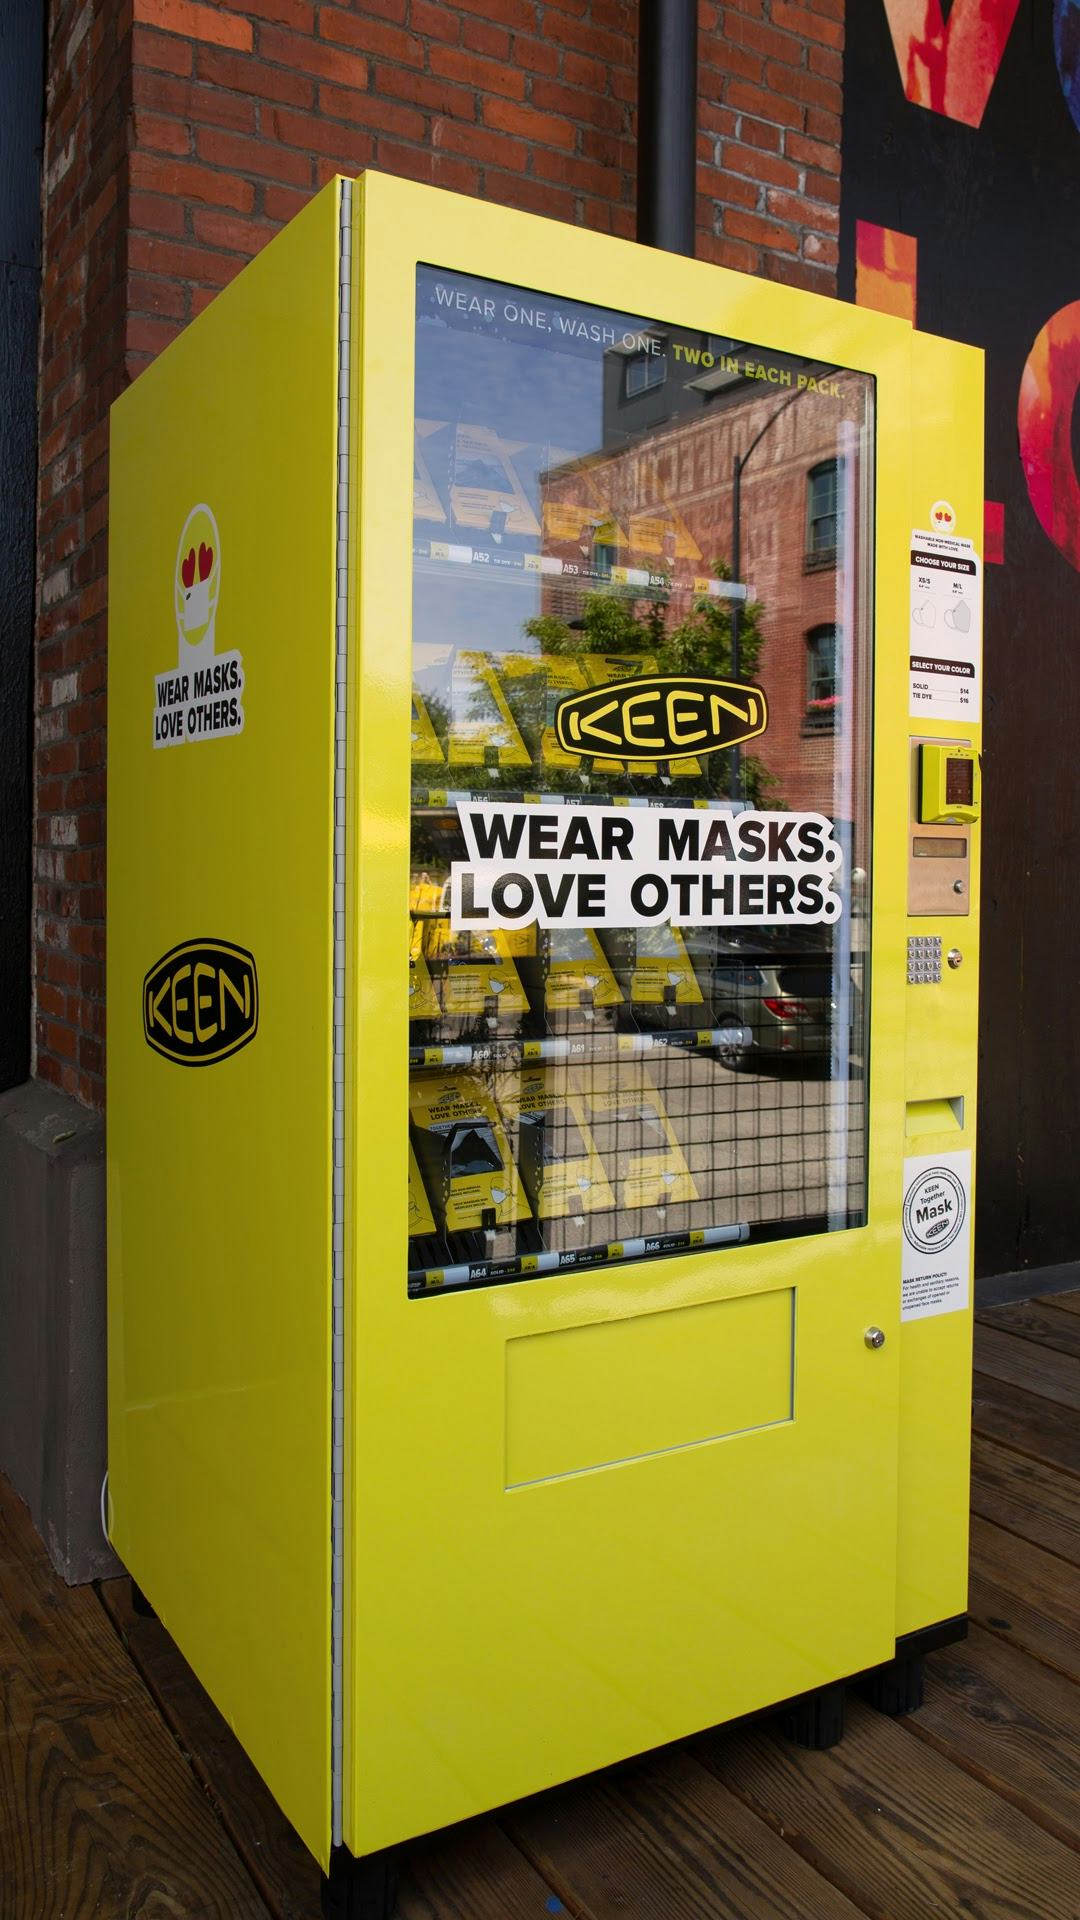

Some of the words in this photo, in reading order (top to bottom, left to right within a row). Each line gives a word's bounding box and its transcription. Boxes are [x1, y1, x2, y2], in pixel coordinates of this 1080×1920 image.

[435, 287, 495, 318] WEAR
[503, 304, 552, 333] ONE,
[559, 316, 616, 345] WASH
[622, 333, 666, 358] ONE.
[672, 344, 715, 368] TWO
[720, 355, 740, 375] IN
[744, 361, 792, 387] EACH
[797, 374, 846, 399] PACK.
[473, 552, 490, 563] A52
[563, 563, 579, 575] A53
[915, 556, 940, 566] CHOOSE
[941, 560, 957, 569] YOUR
[958, 563, 970, 572] SIZE
[650, 575, 665, 586] A54
[912, 661, 933, 670] SELECT
[934, 663, 951, 672] YOUR
[951, 666, 971, 674] COLOR
[157, 675, 189, 708] WEAR
[194, 660, 242, 700] MASKS.
[960, 687, 970, 695] $14
[155, 708, 184, 742] LOVE
[187, 695, 242, 735] OTHERS.
[569, 689, 758, 749] KEEN
[469, 813, 634, 861] WEAR
[658, 818, 836, 863] MASKS.
[461, 872, 606, 919] LOVE
[630, 873, 836, 918] OTHERS.
[148, 962, 251, 1045] KEEN
[571, 1044, 585, 1053] A61
[654, 1038, 668, 1047] A62
[472, 1049, 489, 1060] A60
[428, 1105, 451, 1114] WEAR
[430, 1112, 451, 1121] LOVE
[924, 1184, 940, 1194] KEEN
[920, 1191, 945, 1205] Together
[916, 1198, 953, 1224] Mask
[926, 1218, 949, 1238] KEEN
[646, 1241, 660, 1251] A66
[560, 1253, 575, 1265] A65
[470, 1268, 487, 1279] A64
